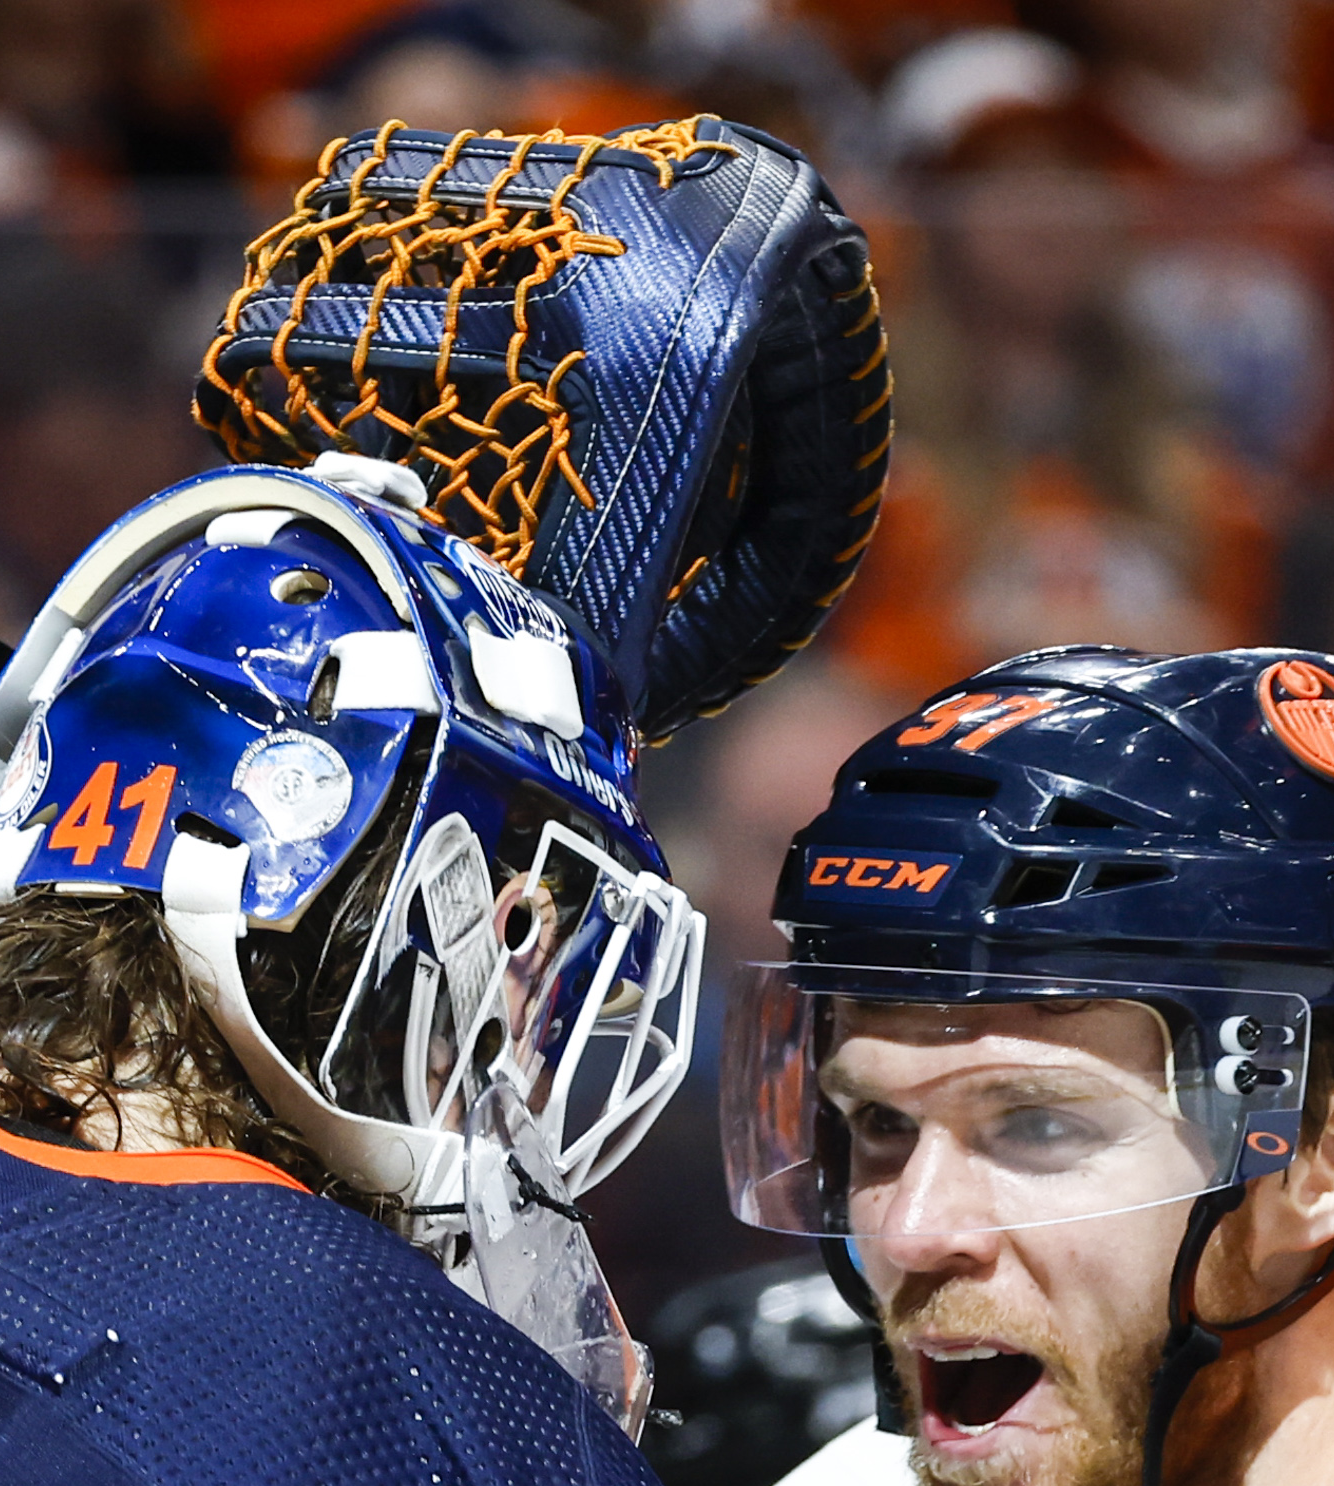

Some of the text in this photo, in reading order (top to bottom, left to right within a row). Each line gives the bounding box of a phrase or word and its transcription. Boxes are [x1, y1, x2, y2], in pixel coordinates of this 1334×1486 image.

[897, 693, 1053, 751] 97
[48, 761, 178, 870] 41
[809, 856, 950, 893] CCM
